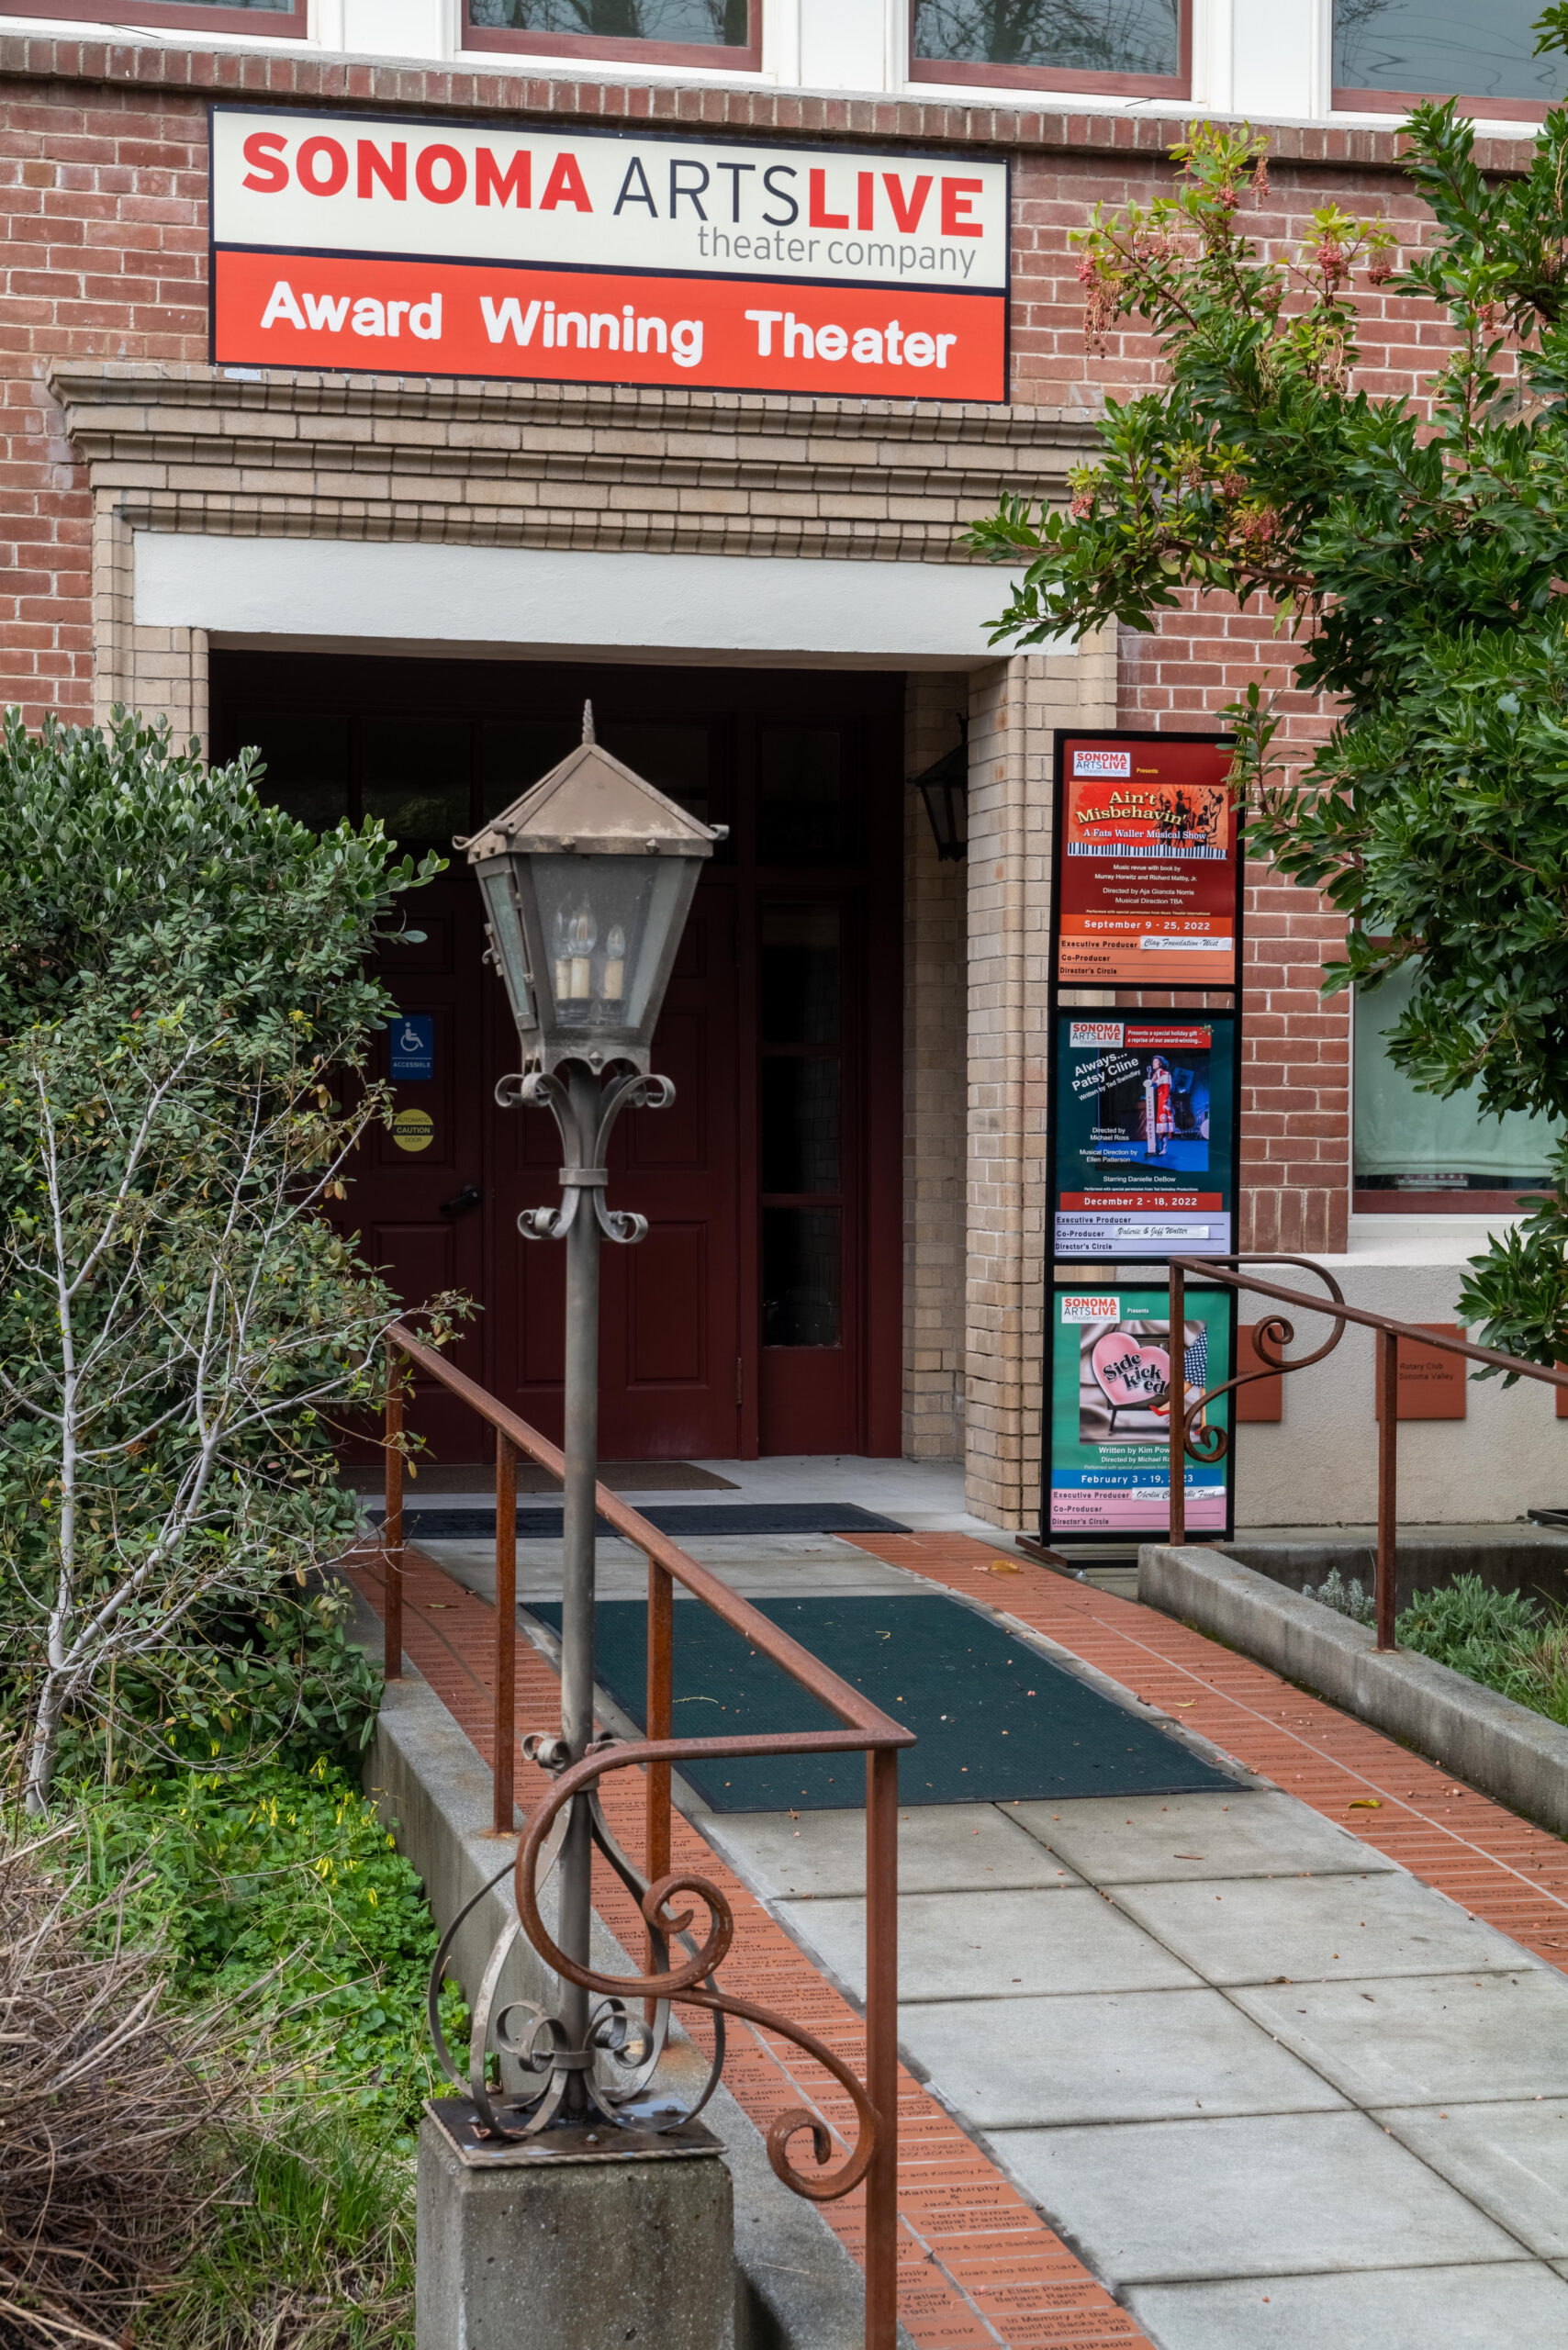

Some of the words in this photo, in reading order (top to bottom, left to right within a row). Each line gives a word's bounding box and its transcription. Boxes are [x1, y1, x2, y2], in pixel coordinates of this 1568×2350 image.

[241, 131, 593, 214] SONOMA
[698, 225, 820, 264] theater
[826, 241, 976, 279] company
[260, 281, 442, 340] Award
[480, 296, 704, 367] Winning
[745, 308, 956, 368] Theater
[1077, 753, 1126, 762] SONOMA
[1109, 791, 1156, 804] Ain't
[1083, 829, 1091, 837] A
[1093, 829, 1112, 837] Fats
[1085, 920, 1140, 929] September
[1164, 922, 1180, 930] 25,
[1144, 938, 1159, 947] Clay
[1071, 1073, 1105, 1091] Patsy
[1108, 1058, 1139, 1076] Cline
[1079, 1090, 1099, 1101] Written
[1106, 1079, 1116, 1088] Ted
[1117, 1069, 1141, 1083] Swindley
[1084, 1197, 1133, 1205] December
[1155, 1198, 1168, 1206] 18,
[1150, 1227, 1163, 1237] Jeff
[1065, 1298, 1116, 1307] SONOMA
[1103, 1354, 1141, 1382] Side
[1123, 1364, 1162, 1388] kick
[1144, 1381, 1166, 1394] ed
[1127, 1447, 1136, 1455] by
[1081, 1475, 1127, 1483] February
[1150, 1475, 1163, 1483] 19,
